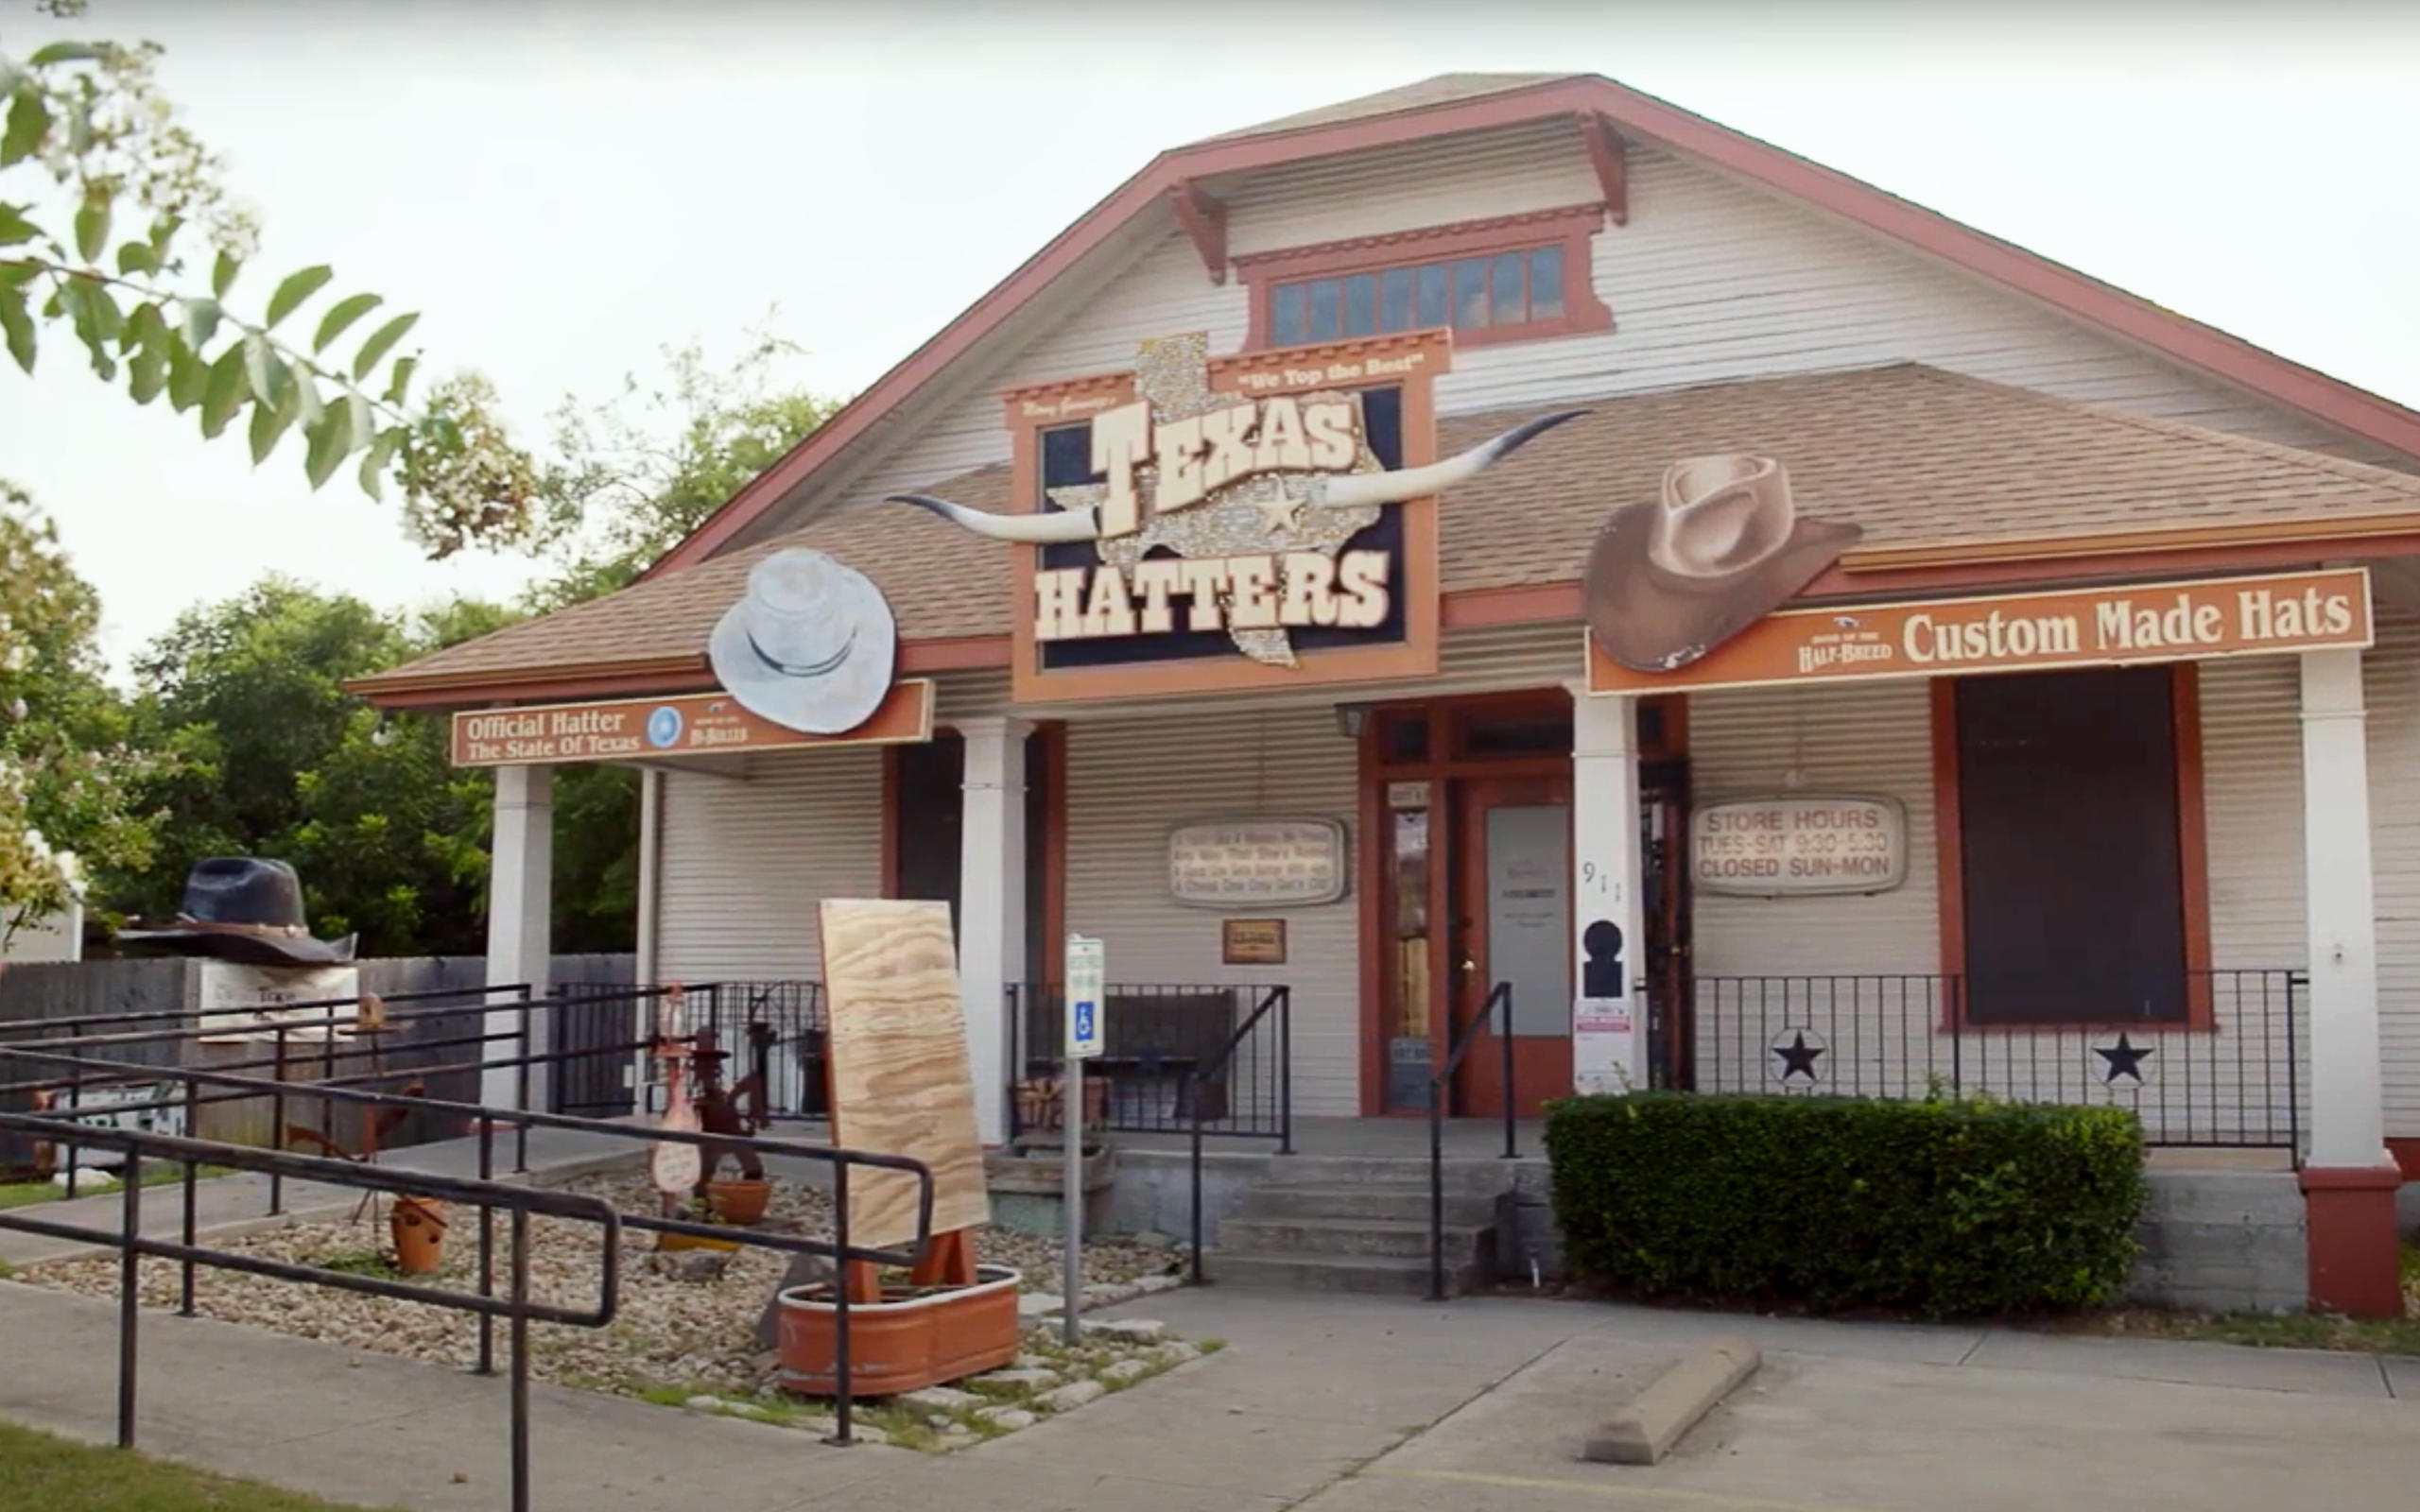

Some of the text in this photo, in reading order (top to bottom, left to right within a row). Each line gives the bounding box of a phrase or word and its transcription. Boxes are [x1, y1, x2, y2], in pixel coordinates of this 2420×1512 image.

[1284, 369, 1322, 386] Top
[1327, 363, 1362, 381] the
[1091, 396, 1356, 539] TEXAS
[1035, 550, 1390, 641] HATTERS
[1902, 588, 2353, 663] Custom Made Hats
[467, 710, 626, 741] Official Hatter
[467, 734, 641, 760] The State Of Texas
[1706, 808, 1879, 833] STORE HOURS
[1701, 855, 1889, 879] CLOSED SUN-MON
